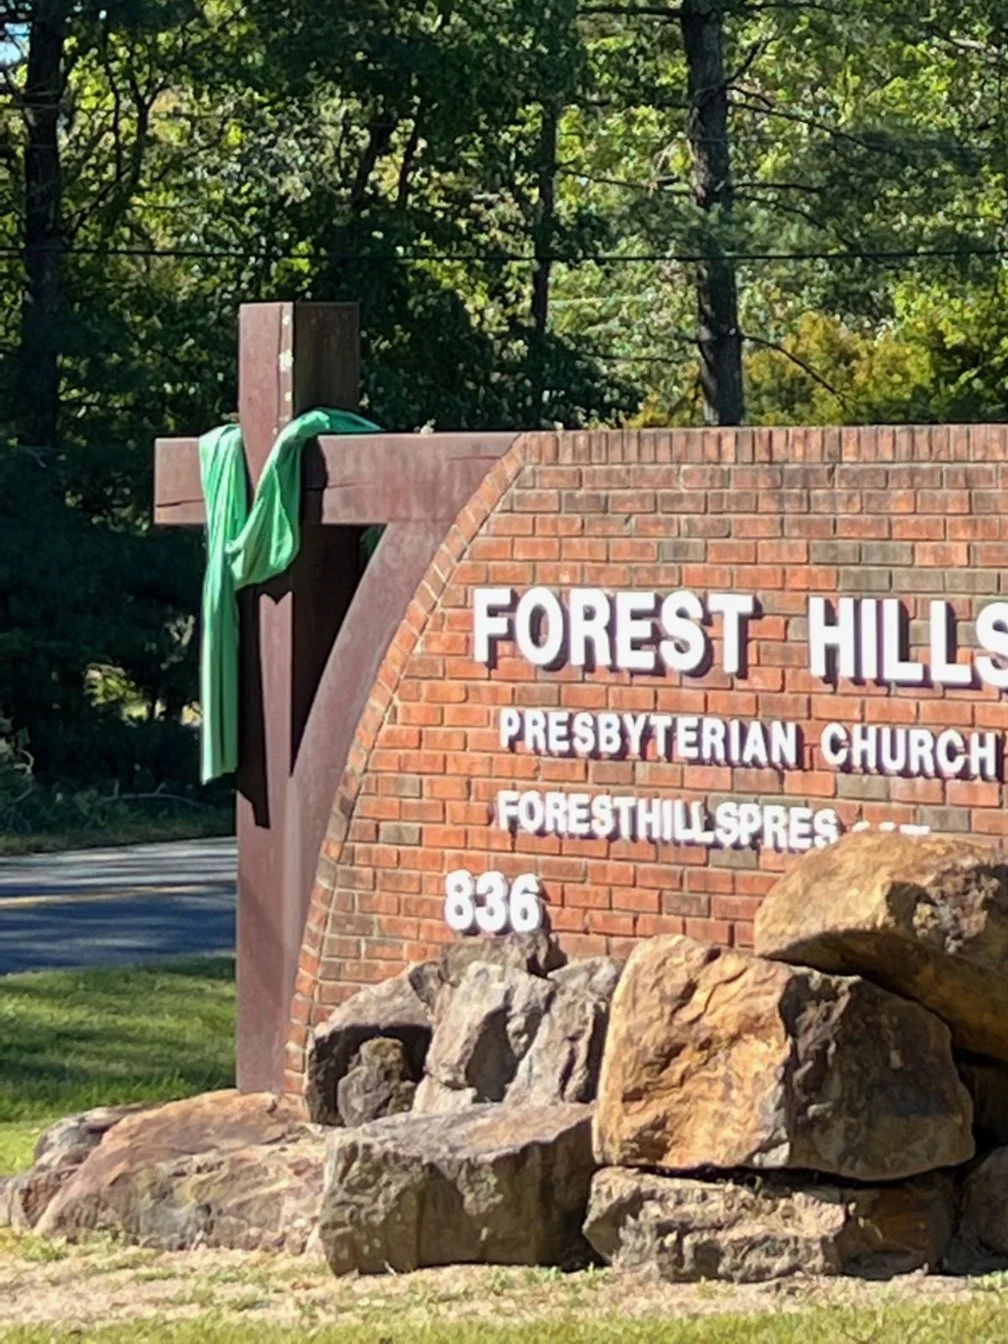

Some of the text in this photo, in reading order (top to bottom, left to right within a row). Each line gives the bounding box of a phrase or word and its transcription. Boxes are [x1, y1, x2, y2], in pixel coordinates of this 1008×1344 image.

[472, 587, 756, 676] FOREST
[499, 707, 999, 778] PRESBYTERIAN CHURCH
[497, 789, 931, 849] FORESTHILLSPRES
[443, 869, 541, 932] 836
